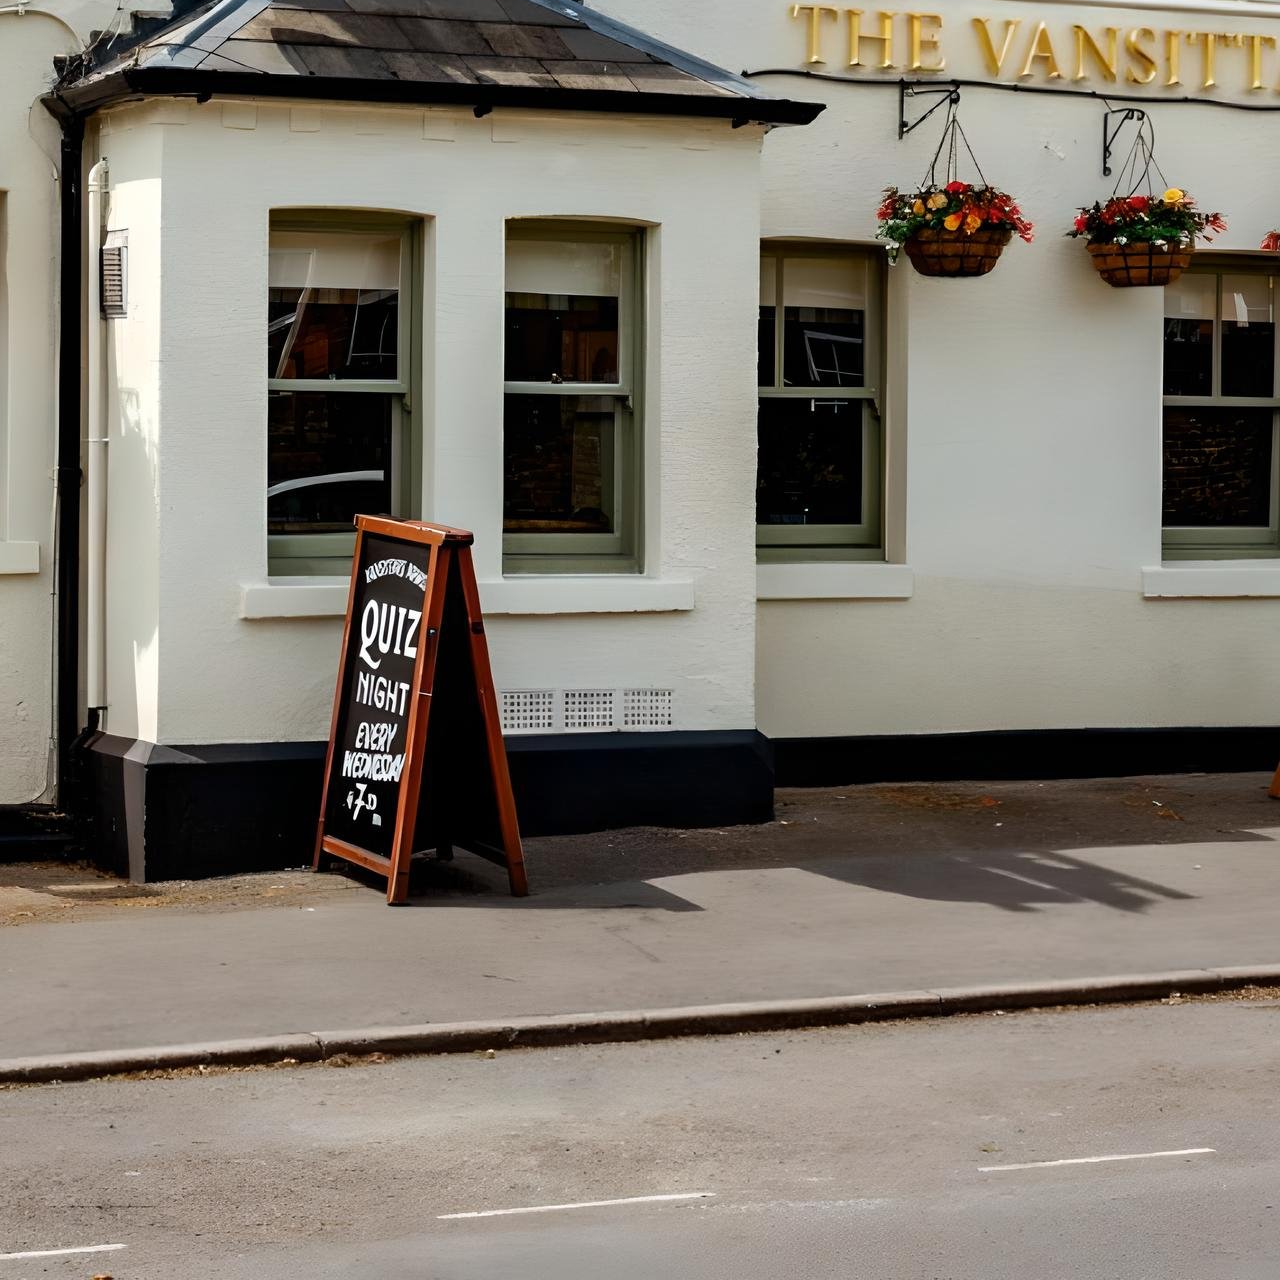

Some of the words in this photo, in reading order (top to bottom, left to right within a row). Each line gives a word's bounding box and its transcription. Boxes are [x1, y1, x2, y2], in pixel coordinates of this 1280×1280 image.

[791, 4, 945, 72] THE
[359, 599, 422, 669] QUIZ
[356, 671, 410, 716] NIGHT
[355, 722, 397, 753] EVERY
